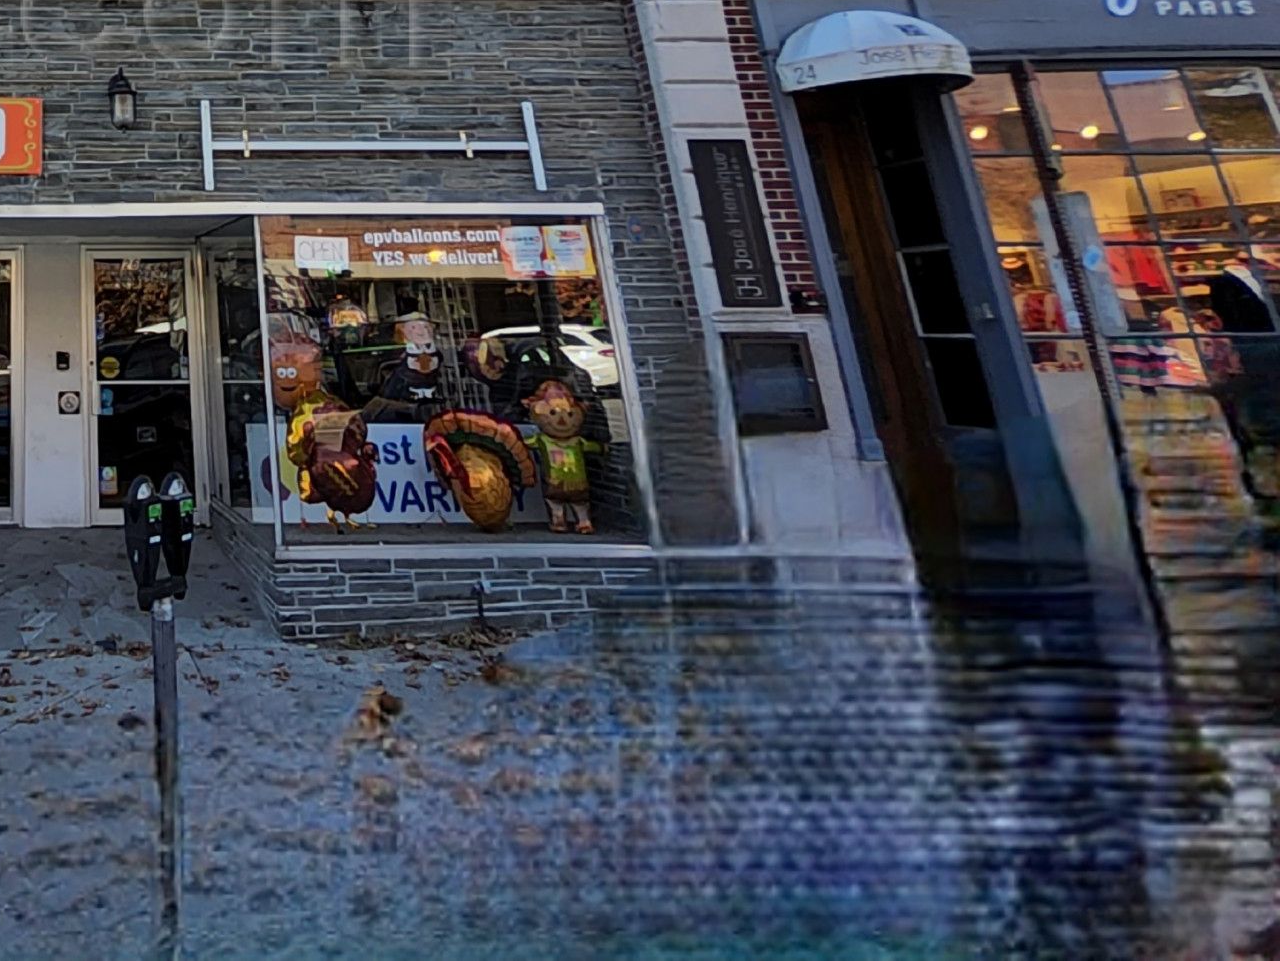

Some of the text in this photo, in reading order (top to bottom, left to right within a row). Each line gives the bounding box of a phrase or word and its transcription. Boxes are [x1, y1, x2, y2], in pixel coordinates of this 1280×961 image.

[1155, 0, 1256, 16] PARIS
[793, 64, 818, 85] 24
[363, 228, 500, 248] epvballoons.com
[298, 239, 345, 262] OPEN
[372, 250, 405, 266] YES
